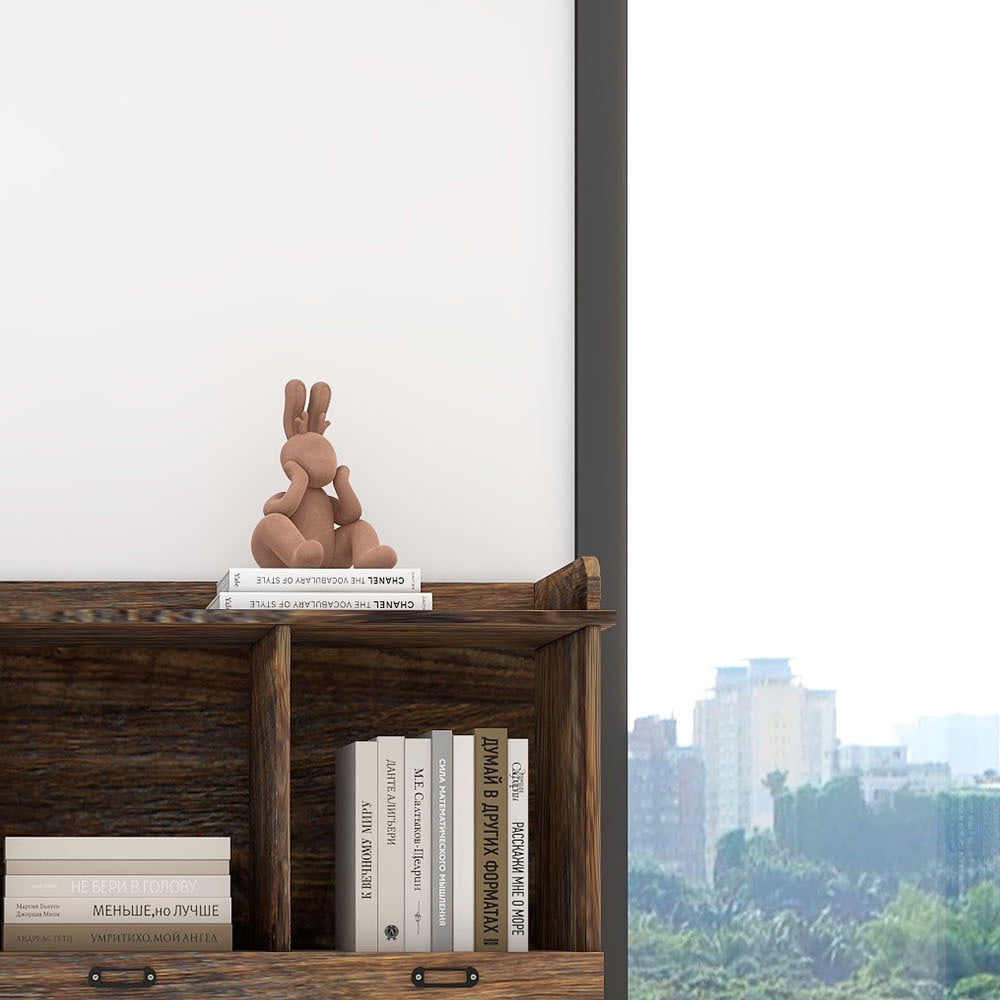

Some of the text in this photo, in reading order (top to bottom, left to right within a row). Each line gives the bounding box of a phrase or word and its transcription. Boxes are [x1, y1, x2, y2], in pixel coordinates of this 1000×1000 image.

[256, 576, 281, 585] STYLE
[282, 576, 294, 585] OF
[295, 576, 349, 585] VOCABULARY
[351, 576, 366, 585] THE
[368, 576, 405, 585] CHANEL
[250, 600, 277, 609] STYLE
[278, 600, 291, 609] OF
[293, 600, 352, 609] VOCABULARY
[354, 600, 371, 609] THE
[373, 600, 415, 609] CHANEL
[481, 736, 503, 786] ДУМАЙ
[483, 789, 499, 799] В
[386, 759, 397, 846] ДАНТЕ АЛИГЬЕРИ
[481, 802, 499, 856] ДРУГИХ
[438, 758, 447, 927] СИЛА МАТЕМАТИЧЕСКОГО МЫШЛЕНИЯ
[511, 821, 525, 874] РАССКАЖИ
[361, 800, 373, 900] К ВЕЧНОМУ МИРУ
[71, 879, 89, 893] НЕ
[91, 879, 127, 893] БЕРИ
[130, 879, 140, 893] В
[143, 879, 198, 893] ГОЛОВУ
[511, 876, 525, 898] МНЕ
[482, 860, 500, 934] ФОРМАТАХ
[173, 904, 220, 917] ЛУЧШЕ
[511, 909, 525, 936] МОРЕ
